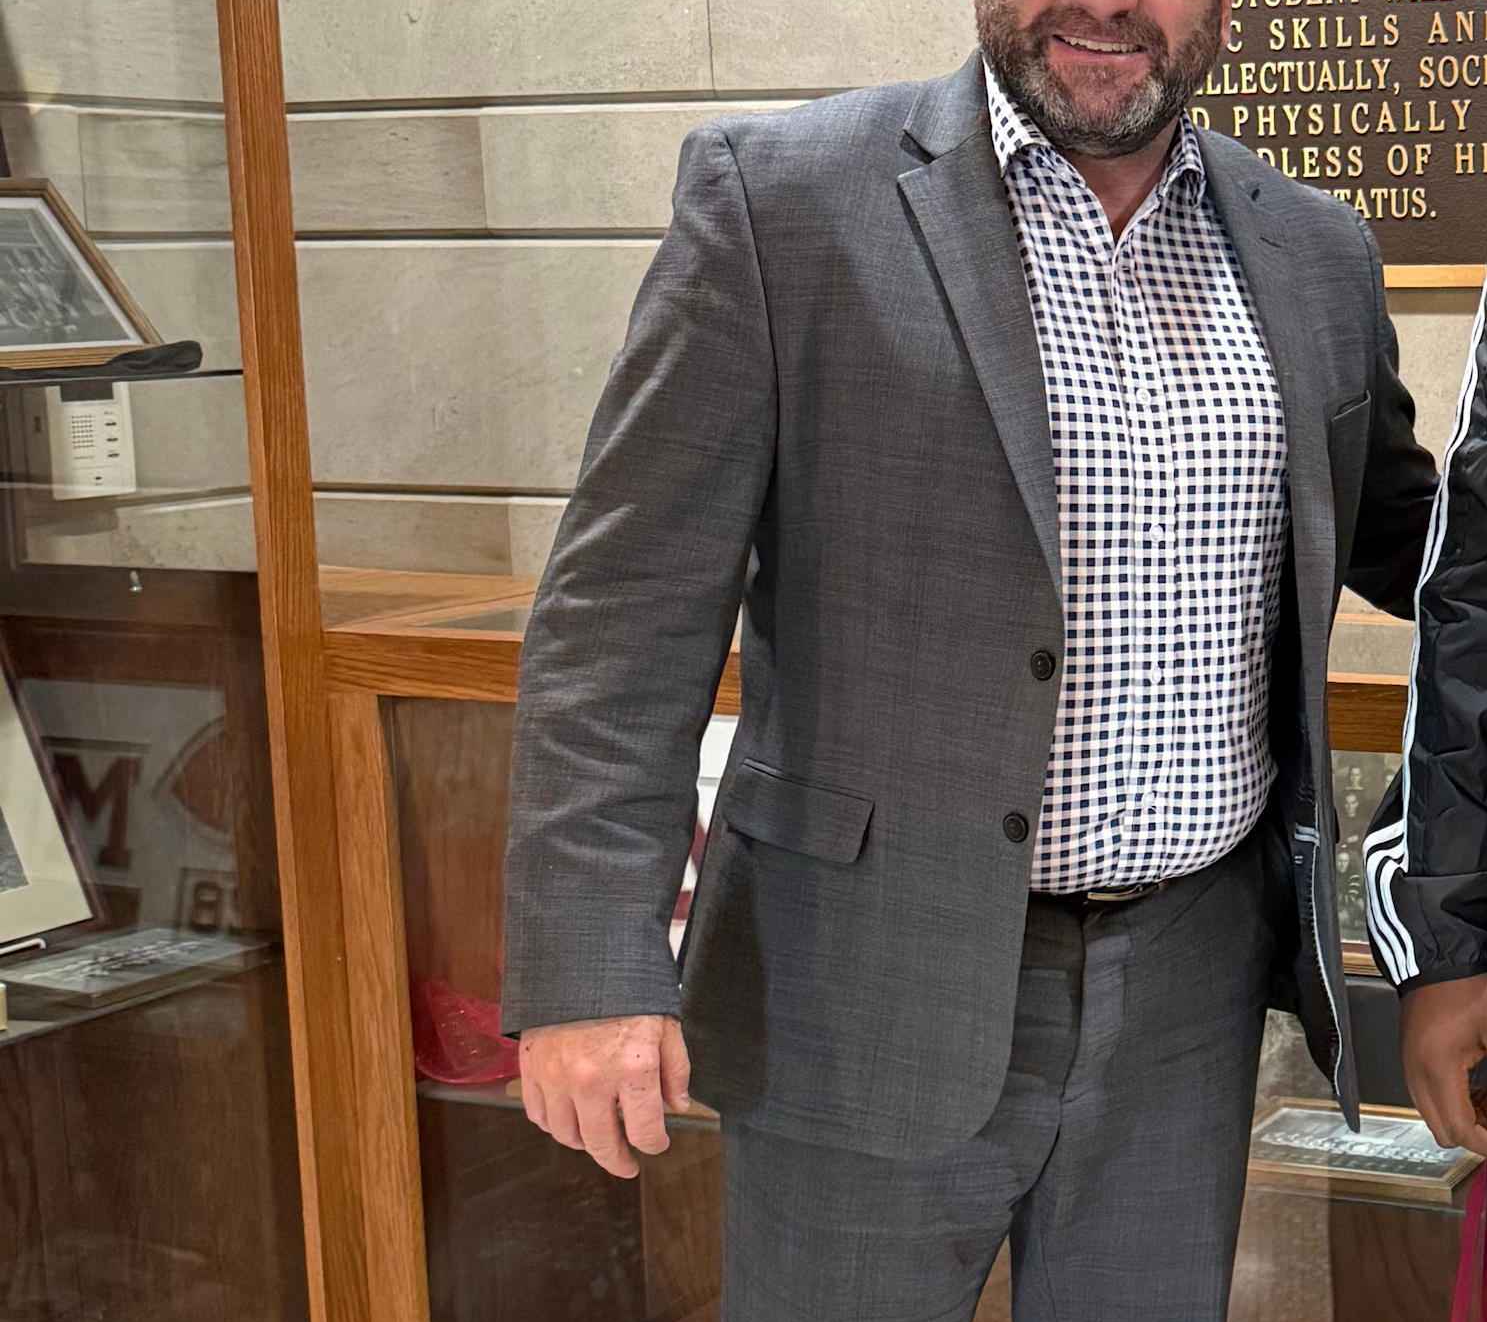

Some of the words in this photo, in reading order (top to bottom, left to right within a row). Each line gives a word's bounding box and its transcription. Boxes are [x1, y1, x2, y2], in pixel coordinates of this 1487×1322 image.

[1269, 14, 1399, 51] SKILLS
[1194, 58, 1400, 97] LLECTUALLY,
[1233, 99, 1472, 137] PHYSICALLY
[1257, 145, 1364, 179] DLESS
[1386, 143, 1432, 176] OF
